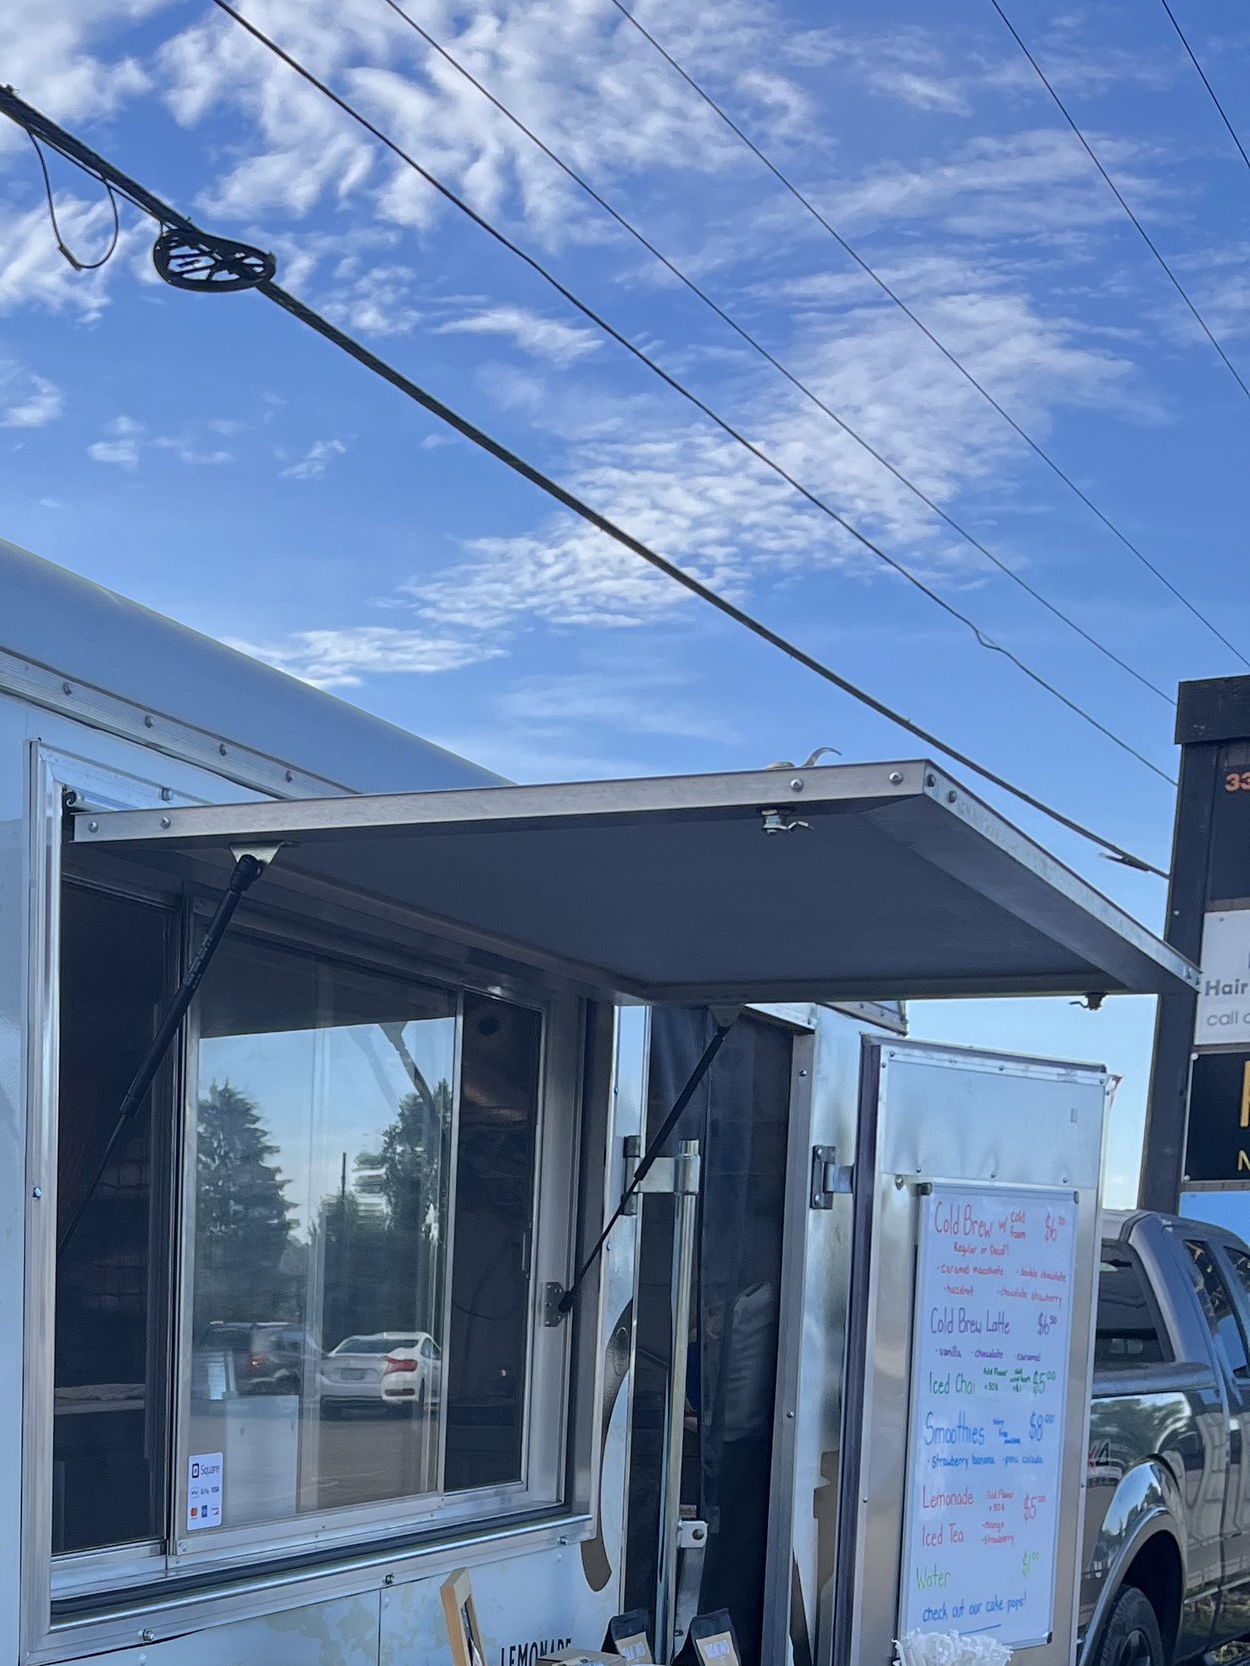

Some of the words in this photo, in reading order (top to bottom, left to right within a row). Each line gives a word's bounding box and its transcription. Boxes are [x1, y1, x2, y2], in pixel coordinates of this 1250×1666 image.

[1205, 979, 1249, 996] Hair
[1207, 1011, 1238, 1026] call
[935, 1201, 960, 1236] Cold
[963, 1204, 993, 1239] Brew
[931, 1307, 954, 1334] Cold
[958, 1307, 982, 1334] Brew
[930, 1371, 950, 1394] Iced
[955, 1372, 976, 1395] Chai
[925, 1409, 985, 1446] Smoothies
[922, 1484, 975, 1509] Lemonade
[922, 1524, 943, 1547] Iced
[948, 1522, 964, 1544] Tea
[916, 1563, 950, 1589] Water
[922, 1601, 949, 1622] check
[953, 1597, 965, 1618] out
